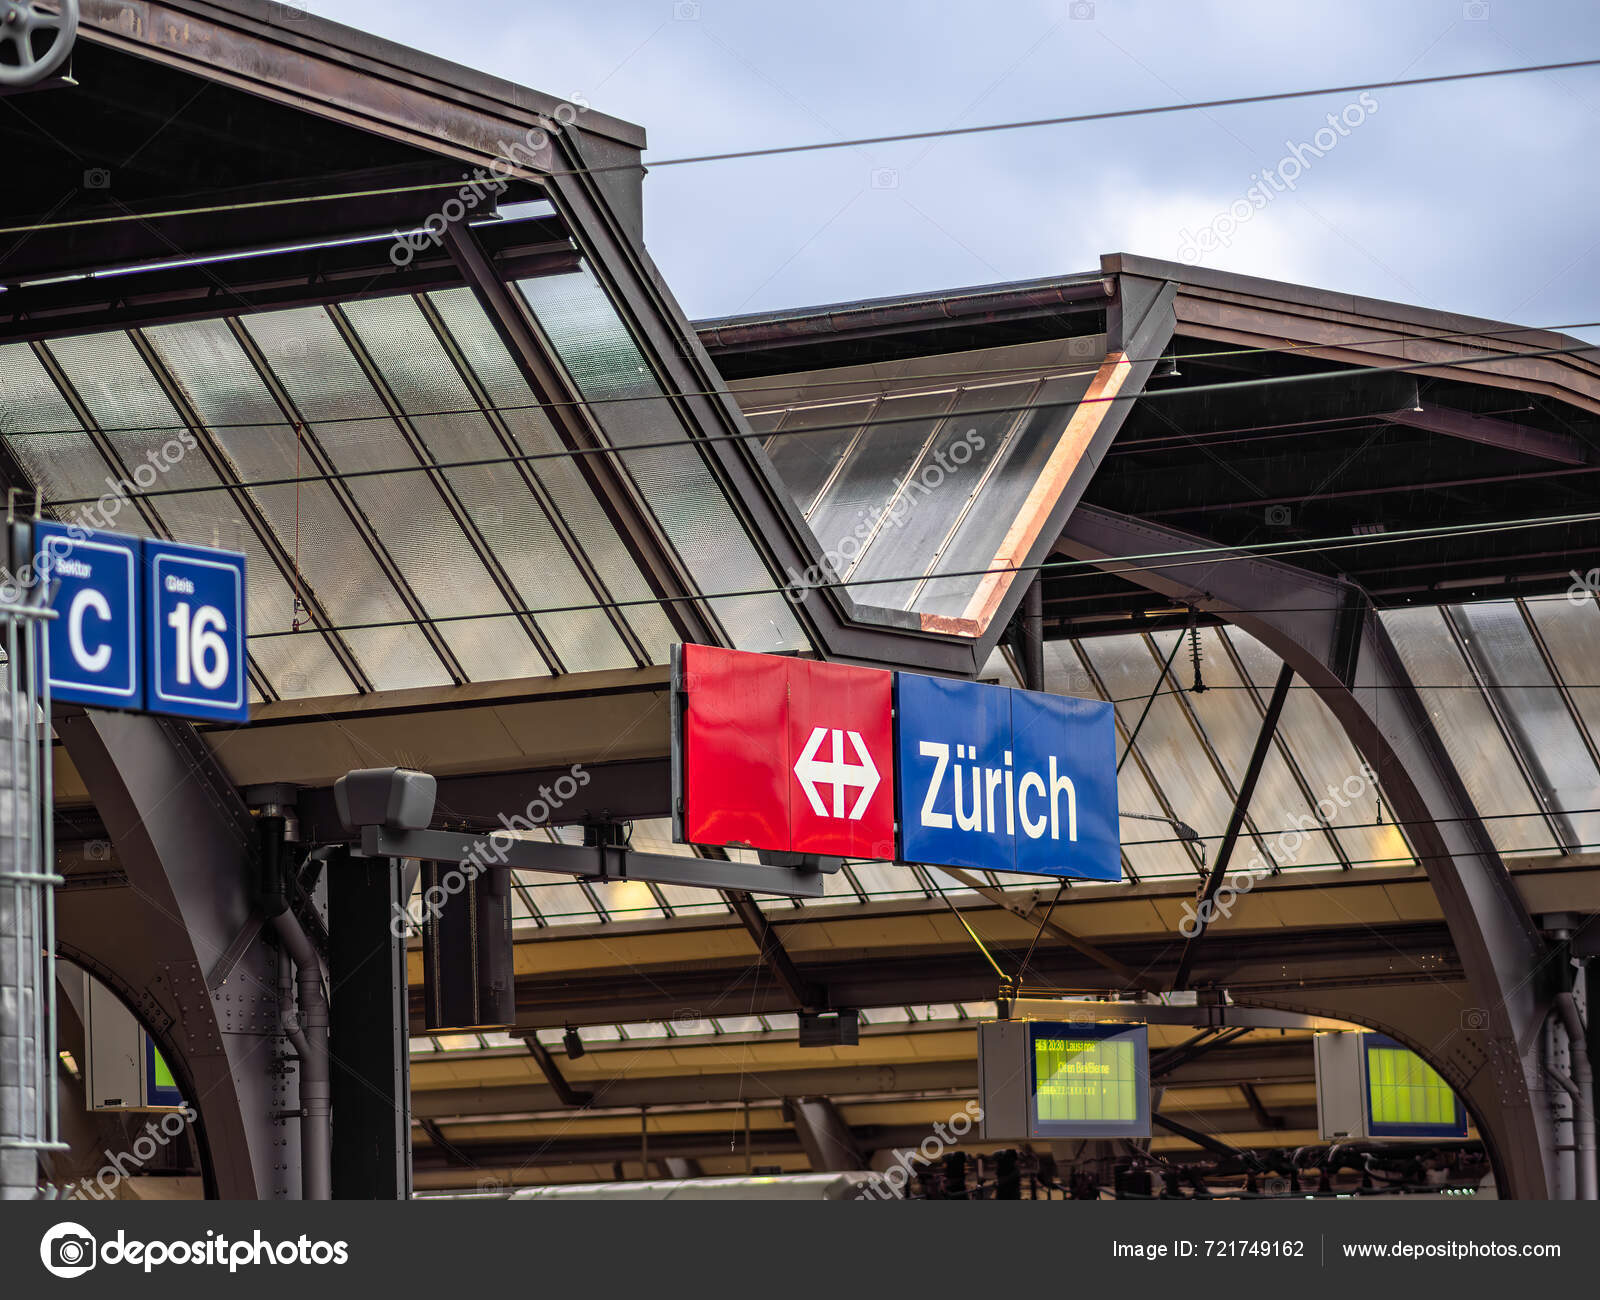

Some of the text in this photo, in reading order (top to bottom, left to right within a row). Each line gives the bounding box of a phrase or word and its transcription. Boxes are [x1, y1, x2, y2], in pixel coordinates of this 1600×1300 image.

[69, 588, 112, 672] C
[168, 602, 229, 689] 16
[920, 741, 1076, 841] Zürich
